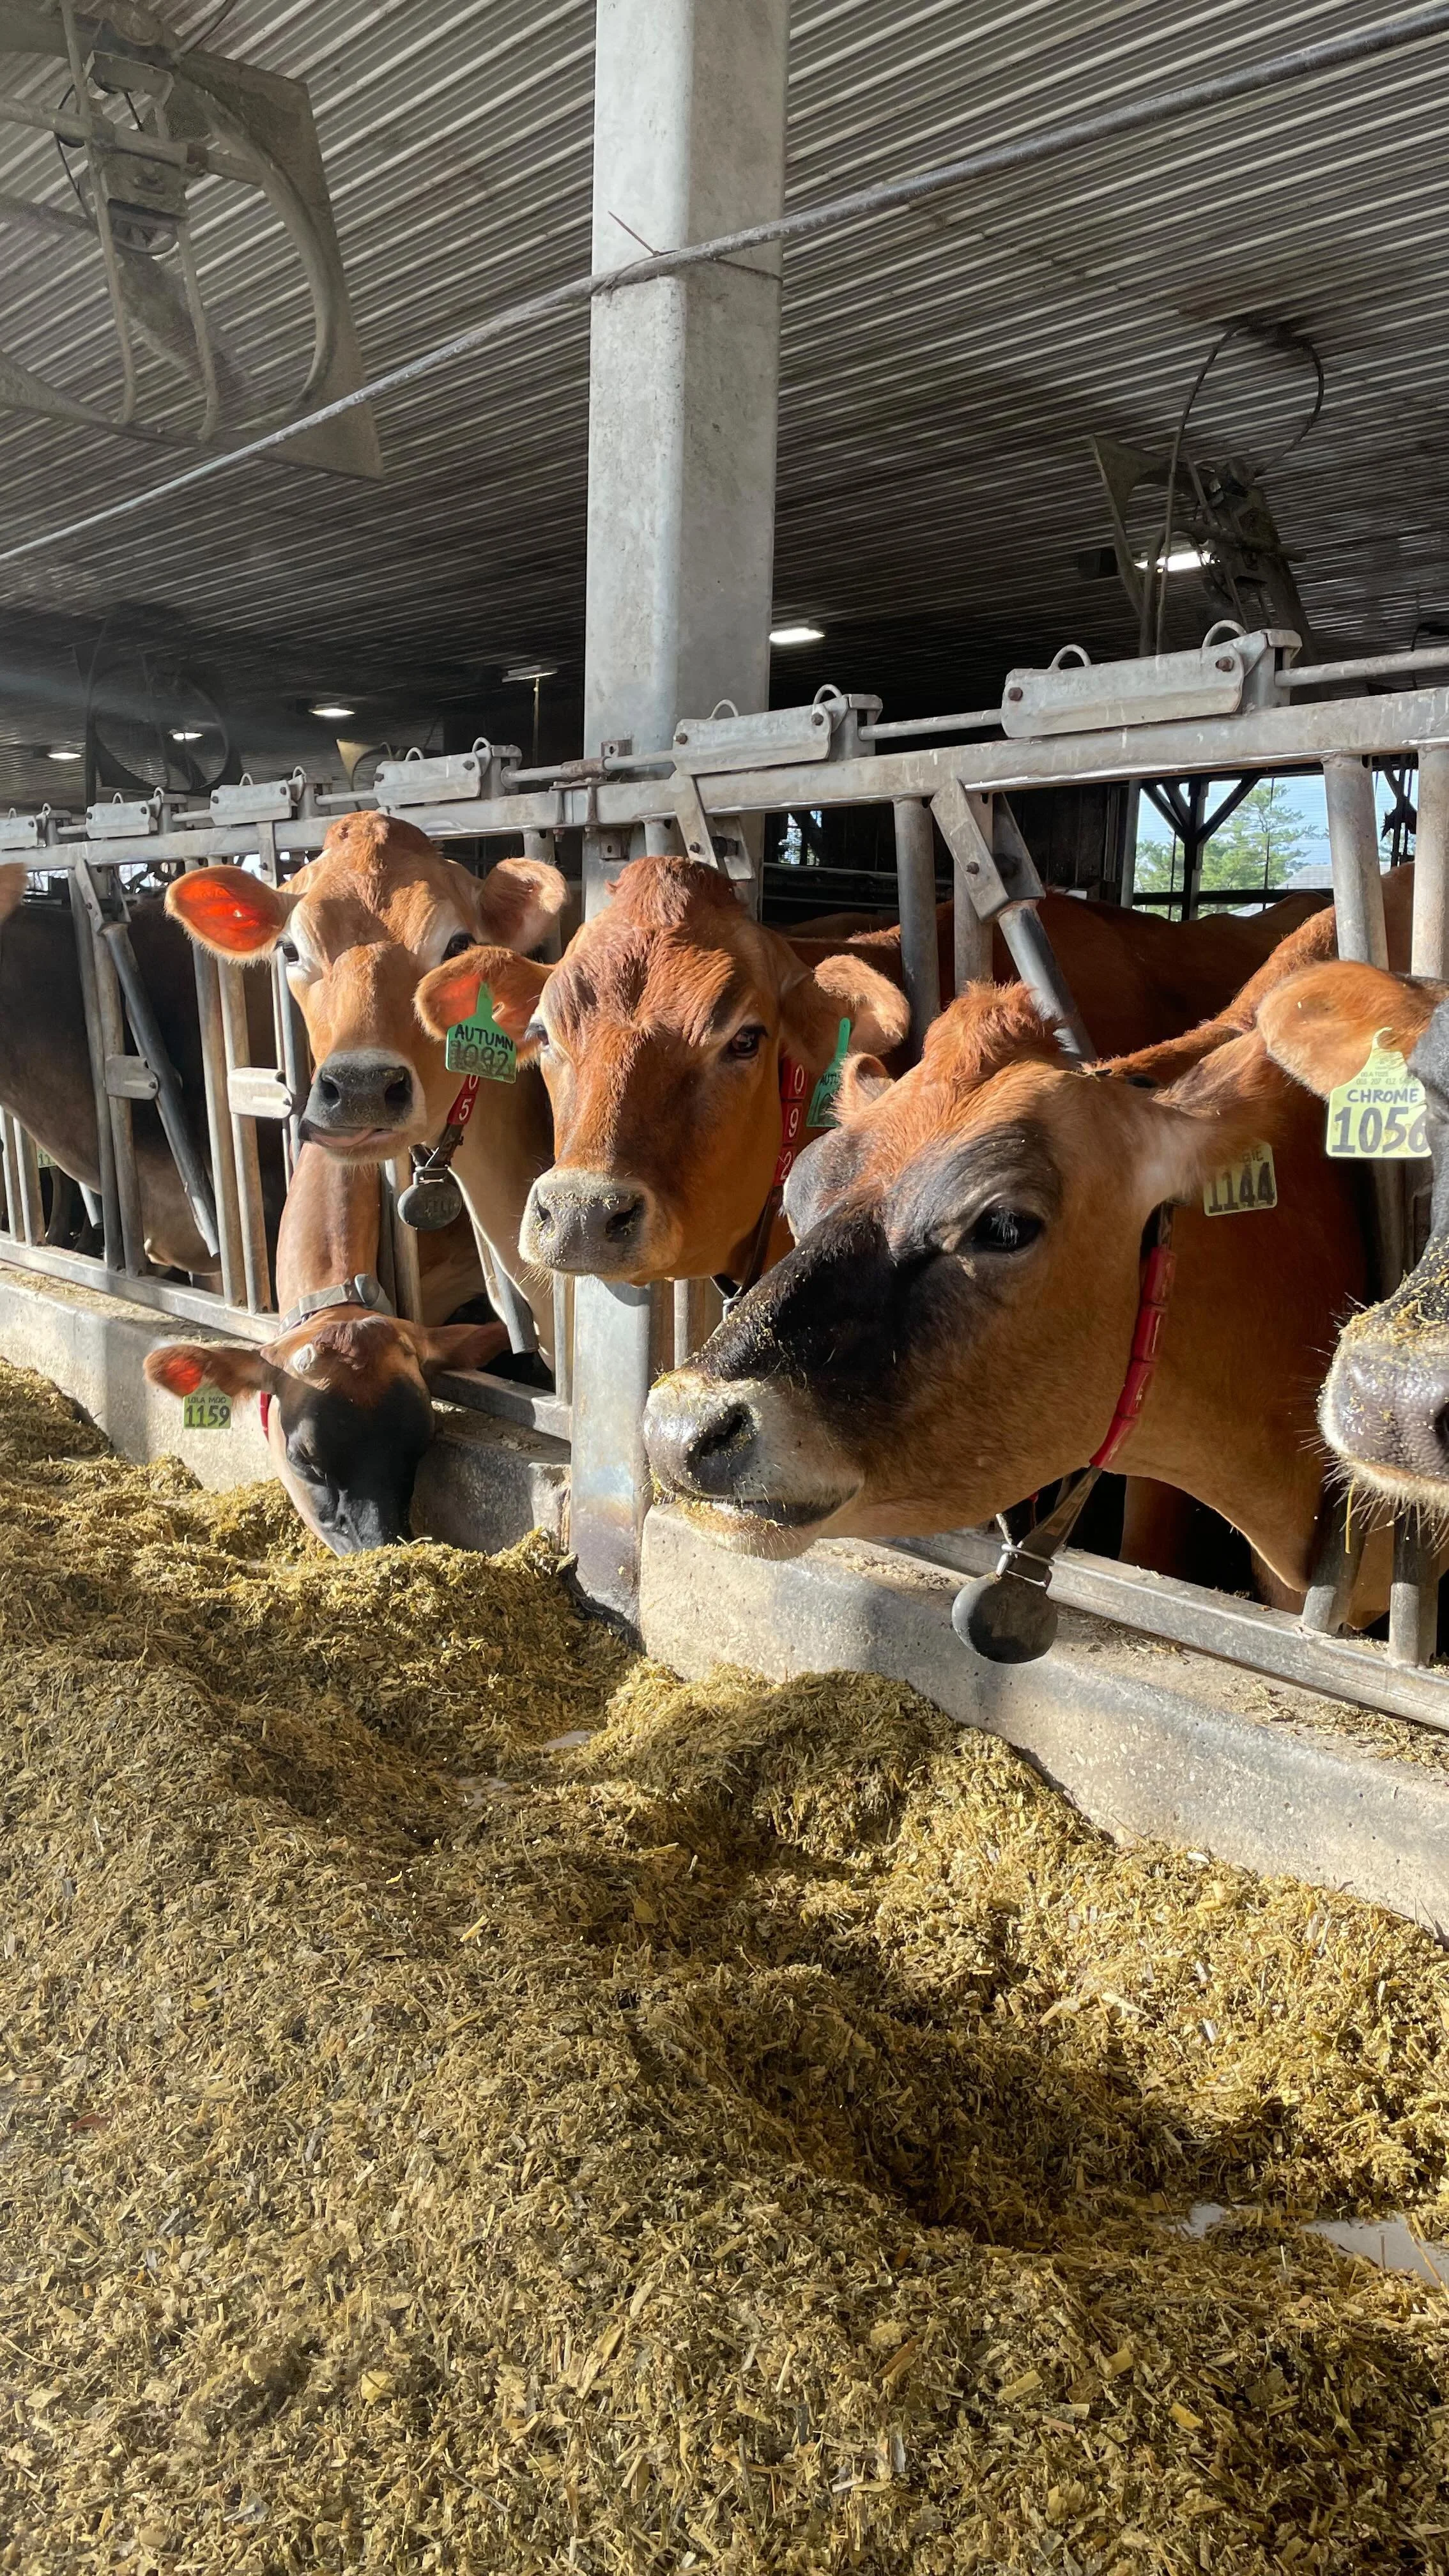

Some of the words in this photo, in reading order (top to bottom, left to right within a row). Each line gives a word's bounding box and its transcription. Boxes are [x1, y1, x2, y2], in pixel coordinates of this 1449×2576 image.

[454, 1023, 514, 1052] AUTUMN
[450, 1040, 512, 1077] 1092
[459, 1098, 471, 1121] 5
[1347, 1088, 1420, 1104] CHROME
[788, 1108, 799, 1138] 9
[1331, 1106, 1429, 1154] 1056
[1209, 1162, 1275, 1213] 1144
[185, 1405, 230, 1427] 1159
